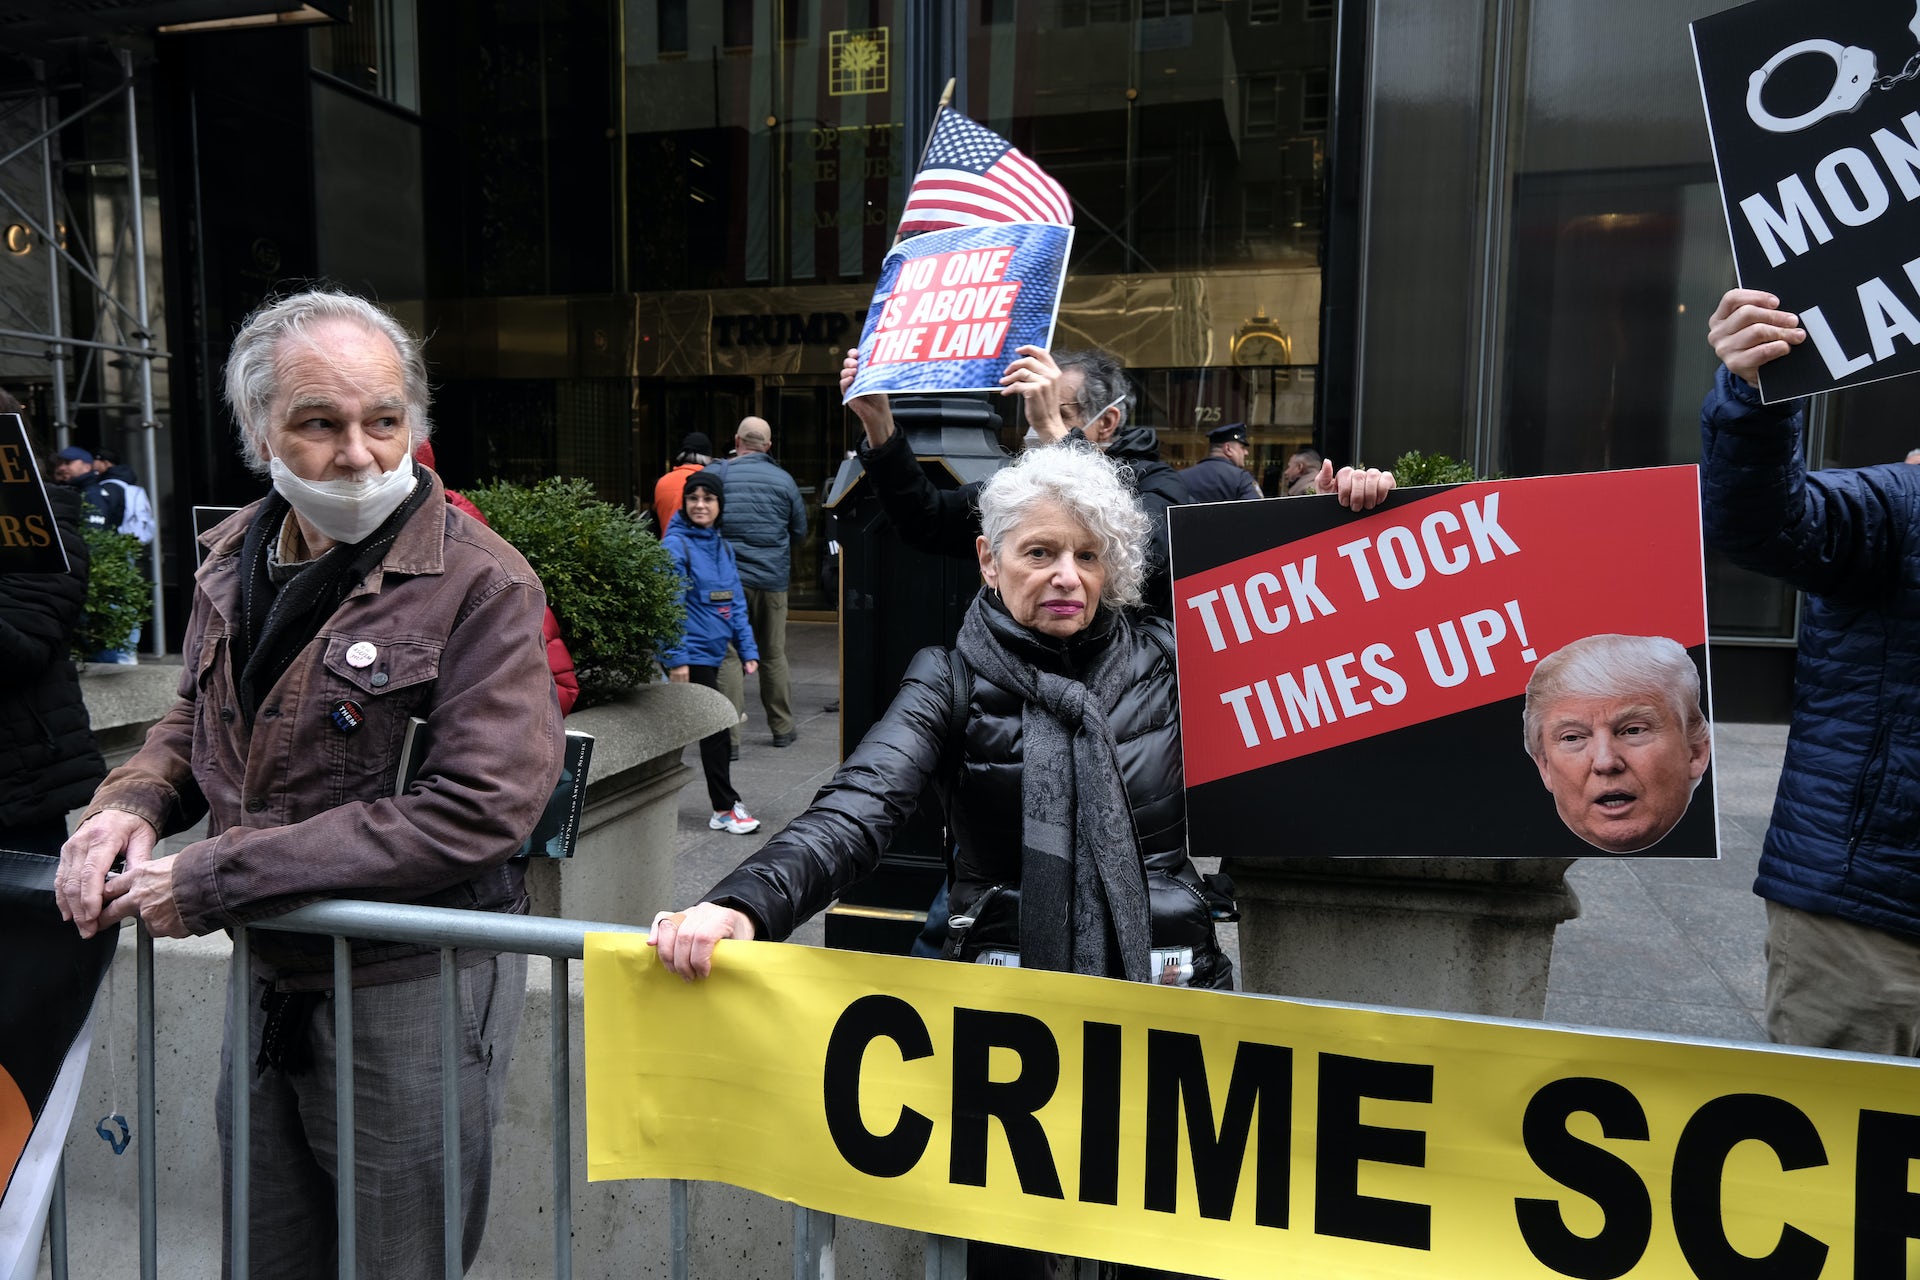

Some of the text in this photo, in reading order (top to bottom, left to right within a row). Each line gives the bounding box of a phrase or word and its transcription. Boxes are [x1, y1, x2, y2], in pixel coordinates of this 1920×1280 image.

[894, 250, 1010, 294] NO ONE
[876, 285, 1018, 331] IS ABOVE
[1799, 256, 1920, 380] LA
[713, 313, 849, 347] TRUMP
[871, 321, 1009, 363] THE LAW
[1194, 406, 1222, 423] 725
[1186, 491, 1521, 652] TICK TOCK
[1220, 600, 1538, 749] TIMES UP!
[331, 711, 350, 732] ALL
[338, 705, 358, 727] THEM
[344, 702, 364, 723] INDICT
[823, 994, 1434, 1251] CRIME
